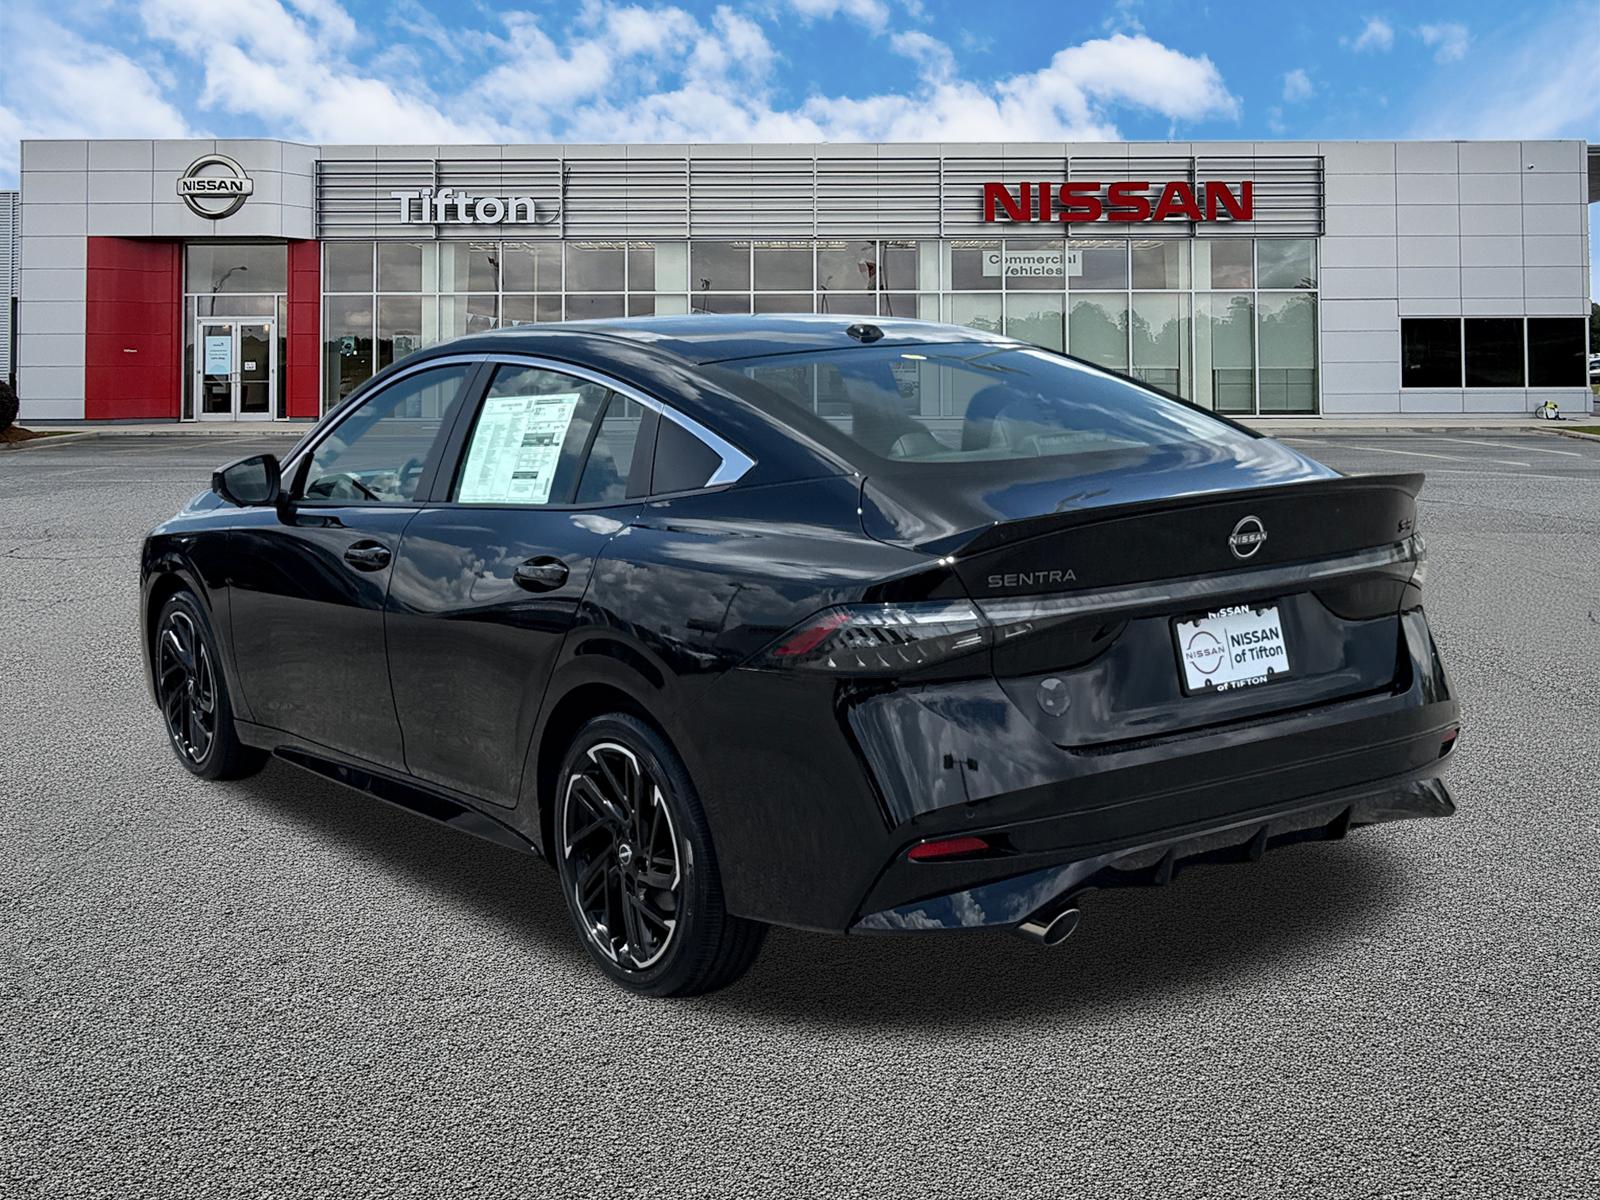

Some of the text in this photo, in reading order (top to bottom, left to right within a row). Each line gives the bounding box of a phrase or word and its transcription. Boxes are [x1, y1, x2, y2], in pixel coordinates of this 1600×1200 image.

[182, 180, 243, 191] NISSAN
[391, 187, 536, 224] Tifton
[984, 181, 1253, 222] NISSAN
[1229, 531, 1267, 545] NISSAN
[988, 569, 1077, 588] SENTRA
[1208, 605, 1249, 619] NISSAN
[1230, 627, 1279, 647] NISSAN
[1186, 645, 1225, 659] NISSAN
[1234, 645, 1284, 663] of Tifton
[1217, 676, 1268, 691] of TIFTON
